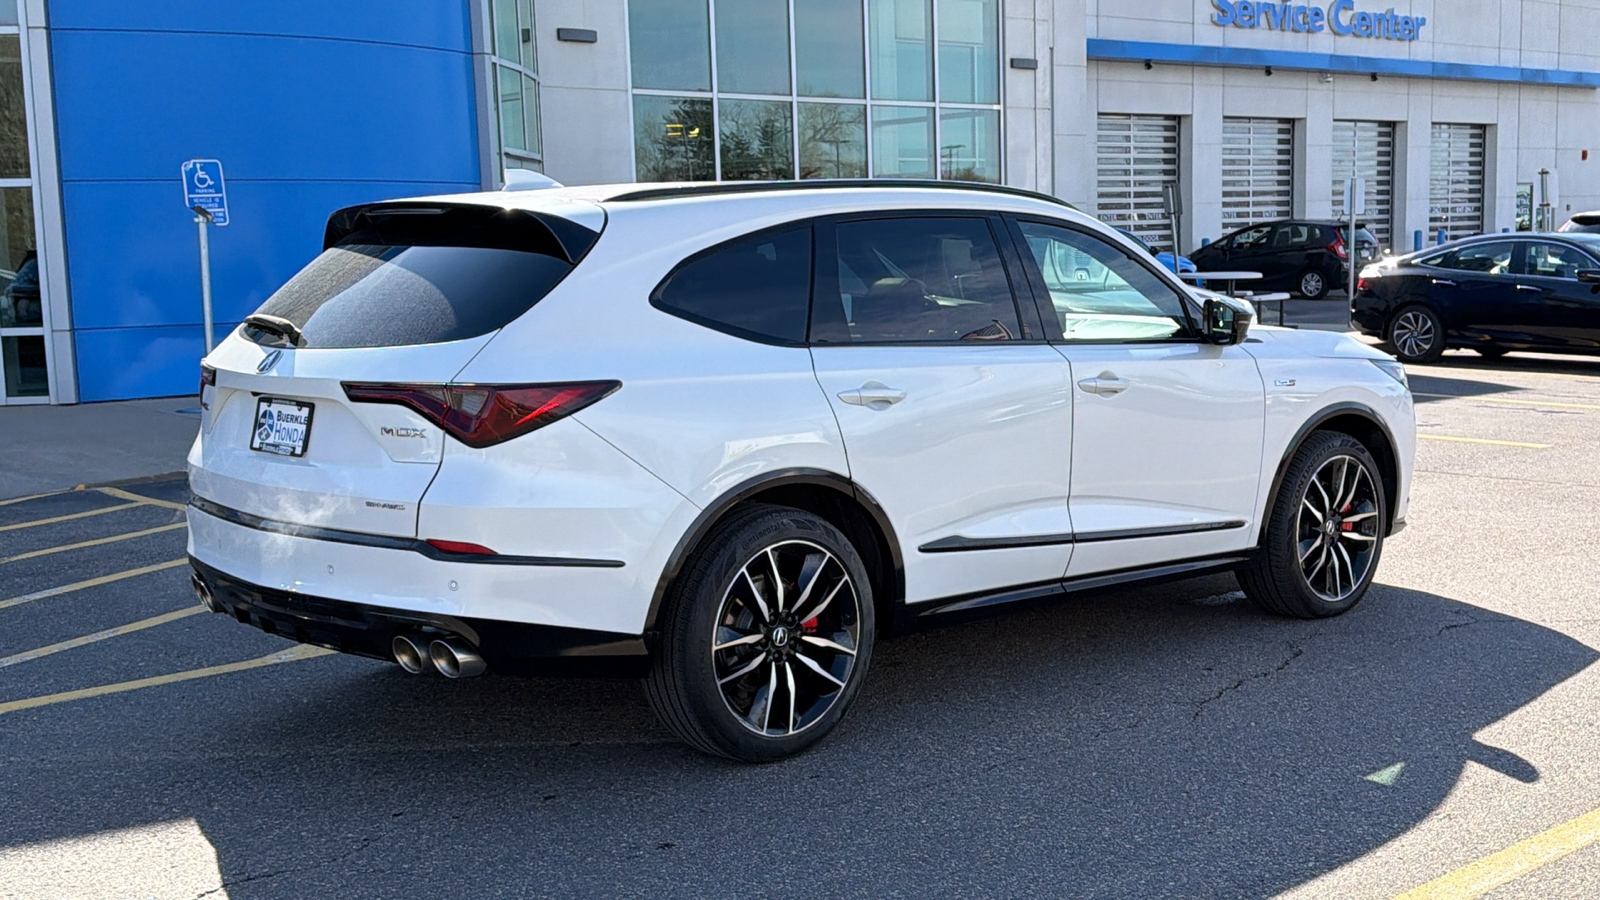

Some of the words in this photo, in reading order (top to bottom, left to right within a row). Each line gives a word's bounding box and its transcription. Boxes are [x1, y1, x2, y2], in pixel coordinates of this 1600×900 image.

[1211, 0, 1325, 33] Service
[1327, 0, 1427, 41] Center
[276, 410, 309, 426] BUERKLE
[273, 422, 305, 444] HONDA
[380, 426, 427, 439] MDX
